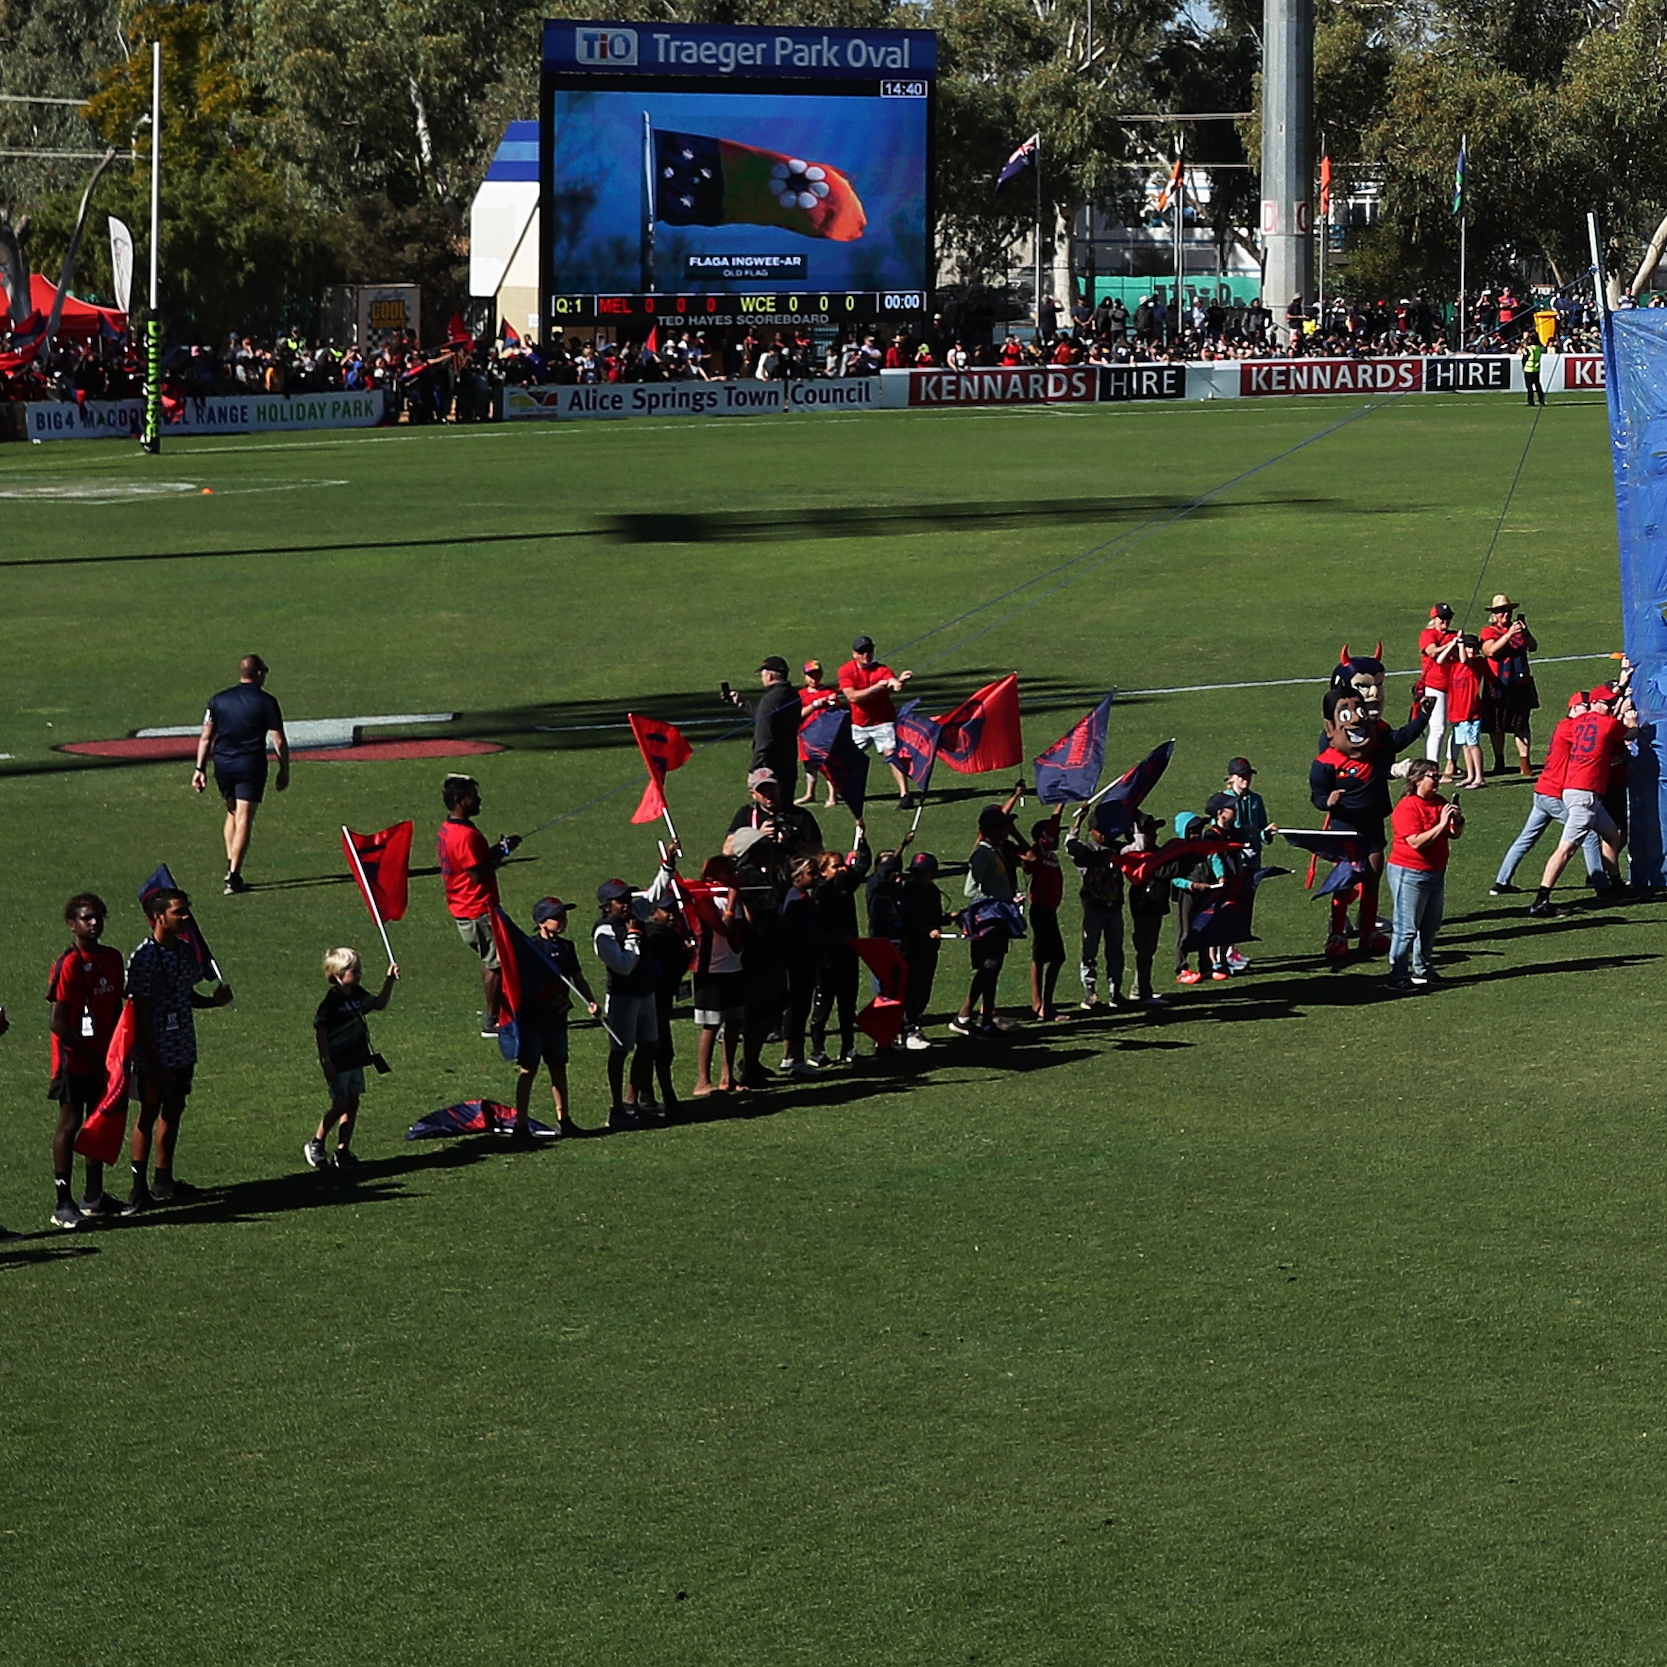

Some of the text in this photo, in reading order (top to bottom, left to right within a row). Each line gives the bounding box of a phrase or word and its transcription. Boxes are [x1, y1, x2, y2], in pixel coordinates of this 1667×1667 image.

[652, 32, 767, 73] Traeger
[774, 35, 841, 68] Park
[846, 37, 911, 69] Oval
[885, 81, 924, 97] 14:40
[689, 256, 801, 267] FLAGA INGWEE-AR
[723, 269, 768, 277] OLD FLAG
[556, 297, 583, 315] Q:1
[599, 298, 717, 315] MEL 0 0 0
[740, 296, 855, 313] WCE 0 0 0
[884, 295, 921, 310] 00:00
[657, 314, 830, 327] TED HAYES SCOREBOARD
[1248, 359, 1503, 394] KENNARDS HIRE
[919, 368, 1178, 403] KENNARDS HIRE
[568, 382, 872, 413] Alice Springs Town Council
[36, 411, 76, 431] BIG4
[197, 404, 249, 425] RANGE
[256, 400, 329, 423] HOLIDAY
[331, 398, 375, 419] PARK
